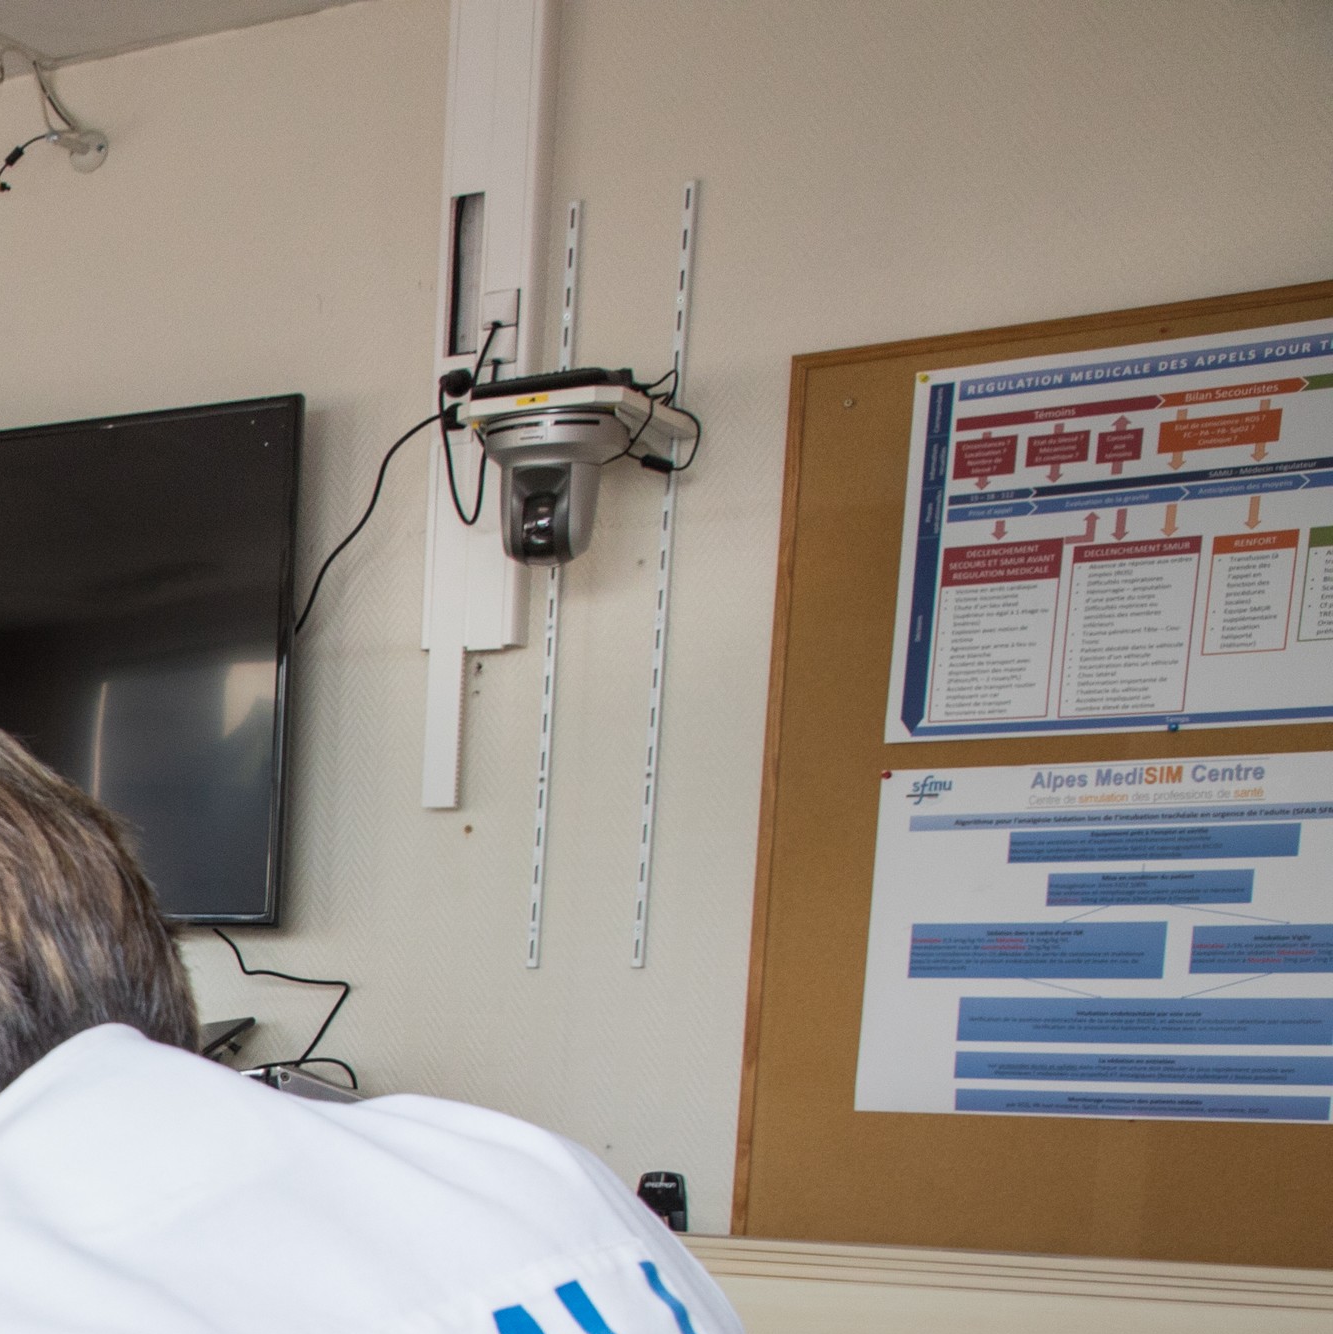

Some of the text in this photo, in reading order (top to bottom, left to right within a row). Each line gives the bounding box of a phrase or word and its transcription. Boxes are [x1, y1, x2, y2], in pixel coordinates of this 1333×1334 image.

[967, 374, 1062, 394] REGULATION
[1070, 363, 1150, 381] MEDICALE
[1158, 358, 1188, 370] DES
[1195, 350, 1255, 366] APPELS
[1264, 343, 1311, 357] POUR
[1185, 383, 1278, 402] Bilan Secouristes
[1034, 406, 1075, 419] Témoins
[1233, 536, 1277, 546] RENFORT
[966, 544, 1038, 558] DECLENCHEMENT
[1084, 541, 1190, 557] DECLENCHEMENT SMUR
[949, 554, 1055, 569] SECOURS ET SMUR AVANT
[952, 565, 1048, 580] REGULATION MEDICALE
[1031, 762, 1265, 790] Alpes MediSIM Centre
[1027, 786, 1264, 806] Centre de simulation des professions de santé
